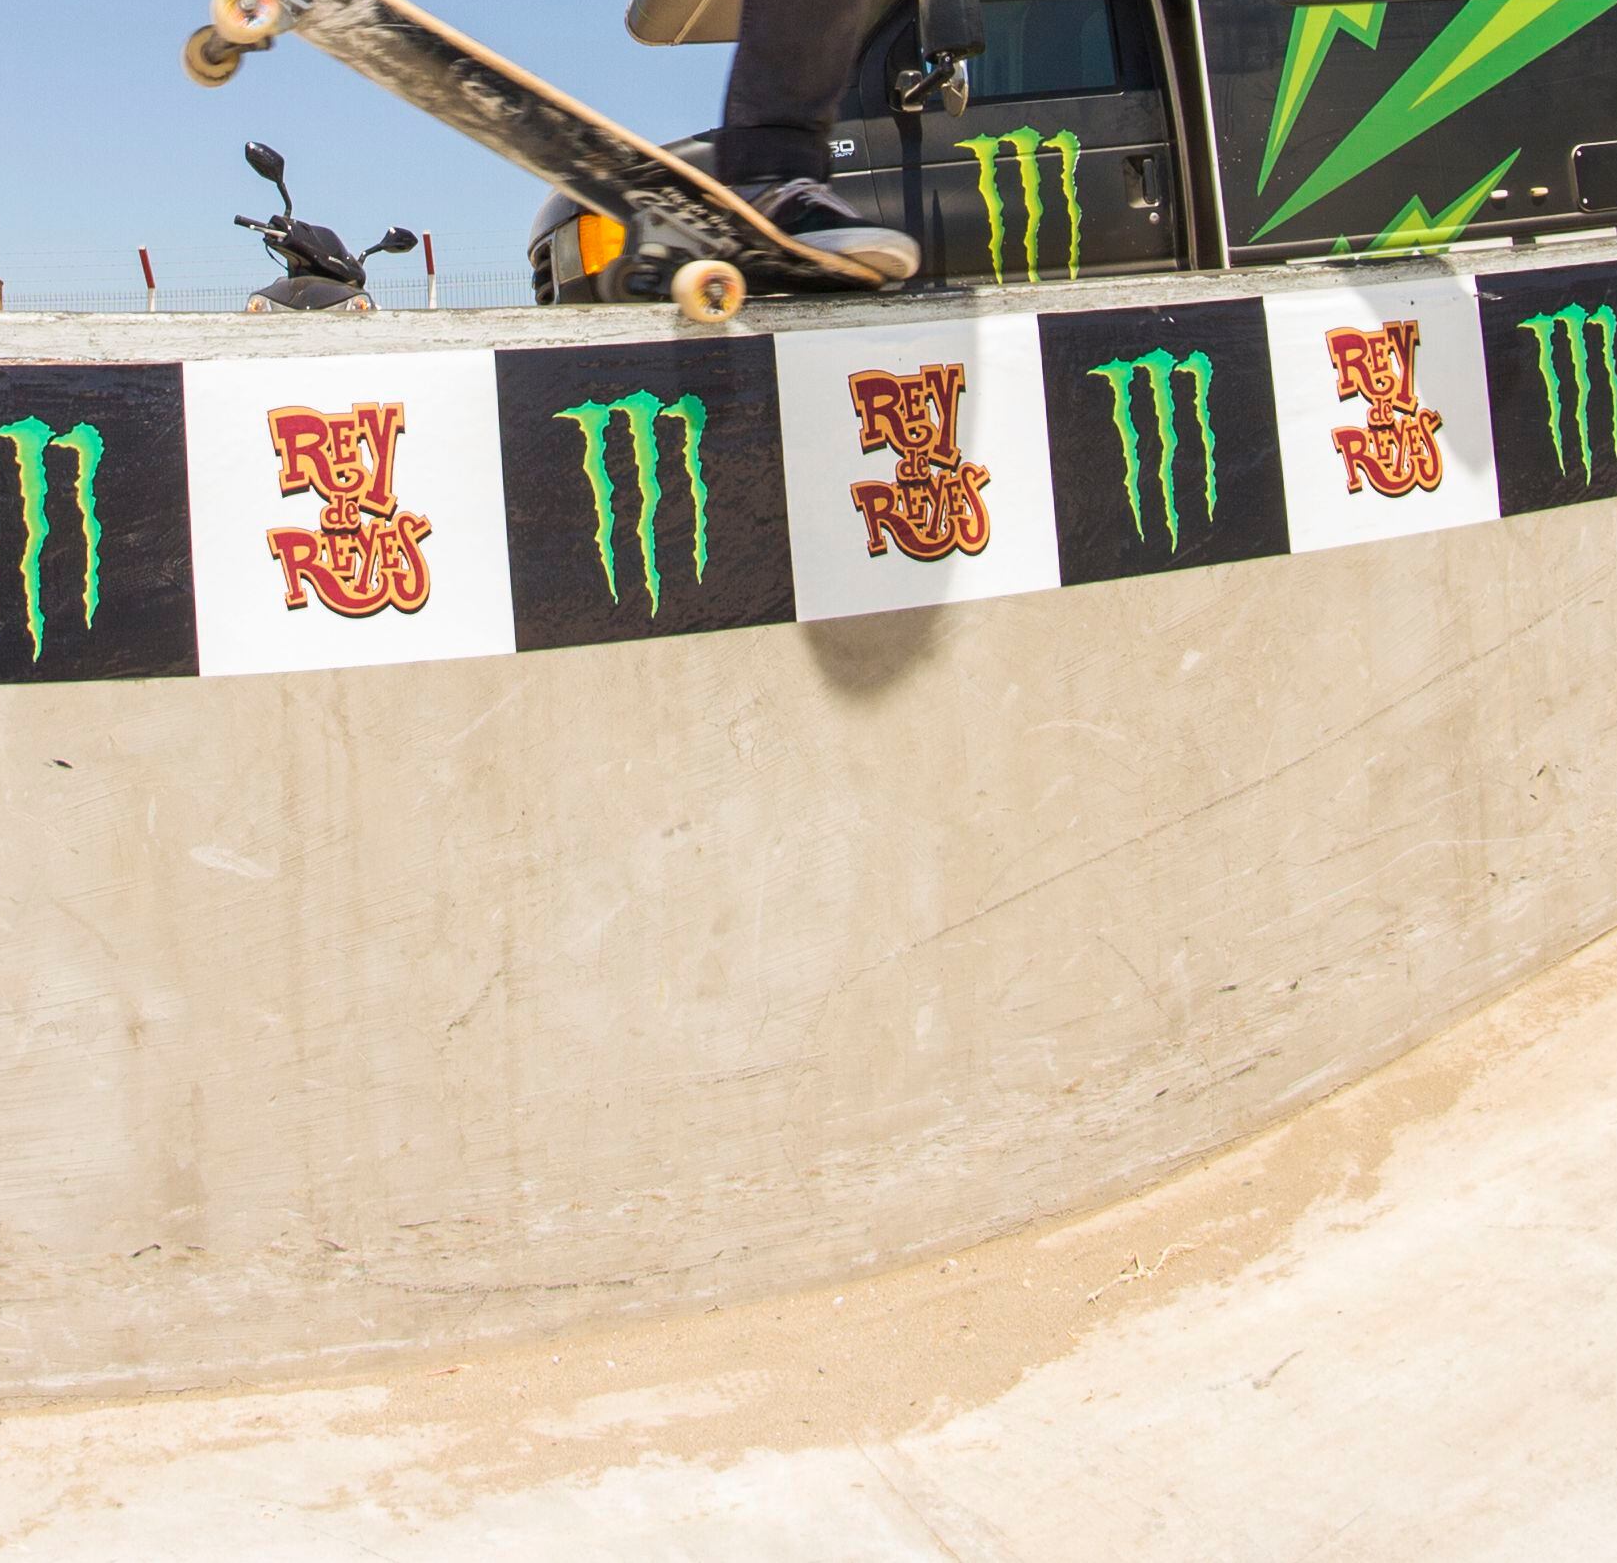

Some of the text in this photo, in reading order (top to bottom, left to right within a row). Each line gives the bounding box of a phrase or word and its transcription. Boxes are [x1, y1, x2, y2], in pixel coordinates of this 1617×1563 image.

[1325, 320, 1420, 412] REY
[1368, 398, 1394, 425] de
[267, 402, 404, 517] REY
[848, 363, 965, 467] REY
[1331, 408, 1442, 494] REYES
[896, 447, 930, 480] de
[321, 492, 360, 529] de
[850, 462, 990, 558] REYES
[267, 511, 431, 615] REYES
